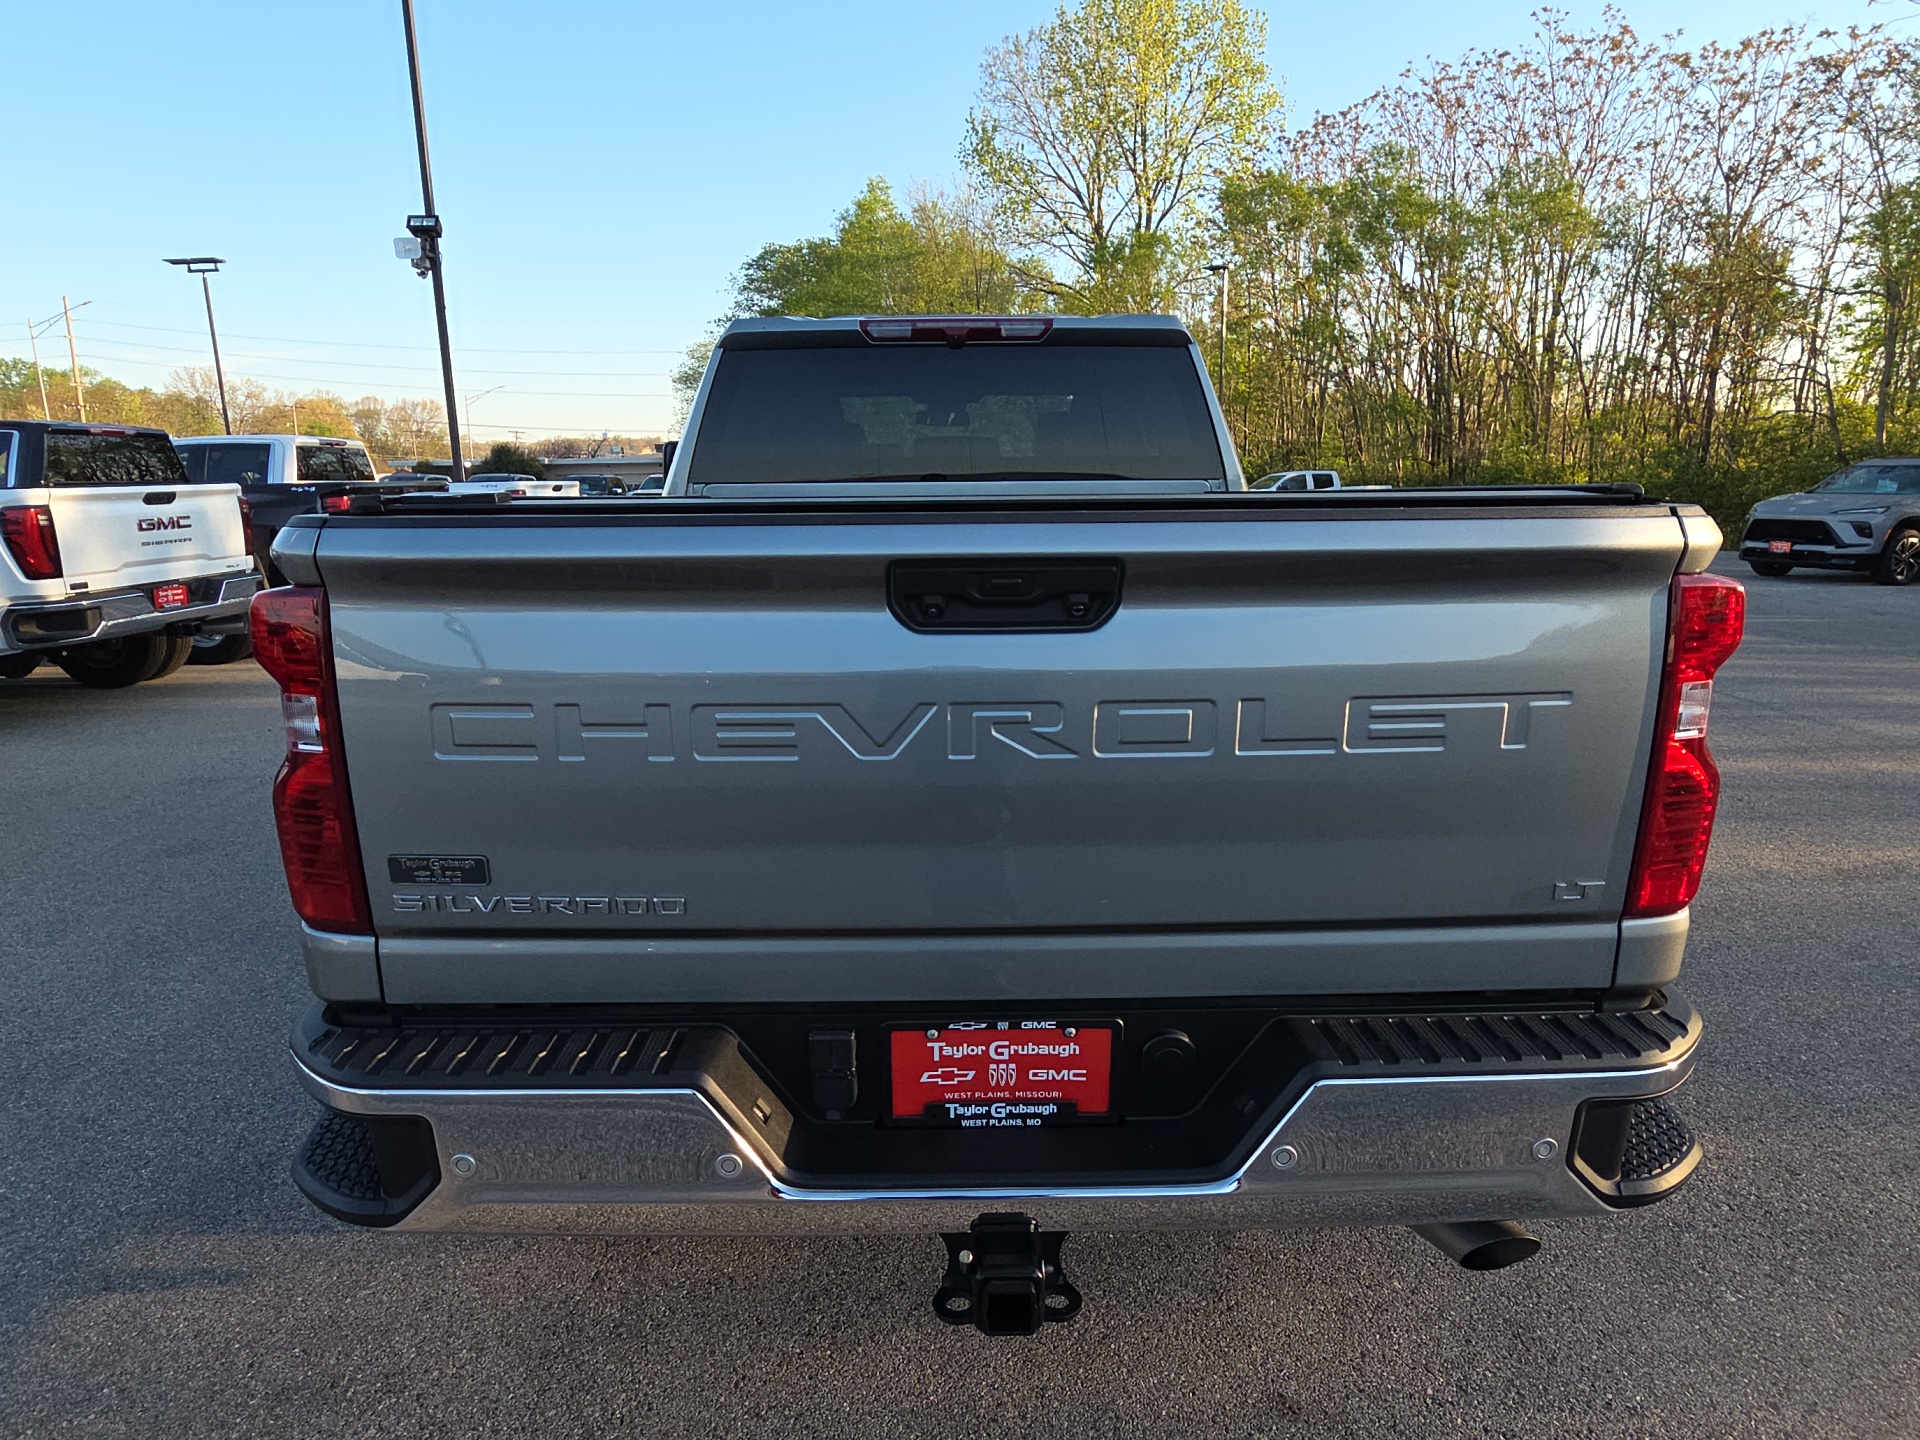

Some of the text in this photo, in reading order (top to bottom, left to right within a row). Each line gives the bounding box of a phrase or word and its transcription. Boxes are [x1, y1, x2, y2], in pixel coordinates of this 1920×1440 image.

[137, 515, 192, 532] GMC
[141, 537, 192, 546] SIERRA
[429, 691, 1573, 763] CHEVROLET
[398, 858, 475, 869] Taylor Grubaugh
[1553, 881, 1606, 900] LT
[393, 894, 686, 915] SILVERADO
[1021, 1021, 1056, 1029] GMC
[927, 1041, 1080, 1061] Taylor Grubaugh
[1028, 1069, 1087, 1081] GMC
[944, 1091, 972, 1099] WEST
[945, 1103, 1057, 1118] Taylor Grubaugh
[961, 1118, 1041, 1127] WEST PLAINS, MO
